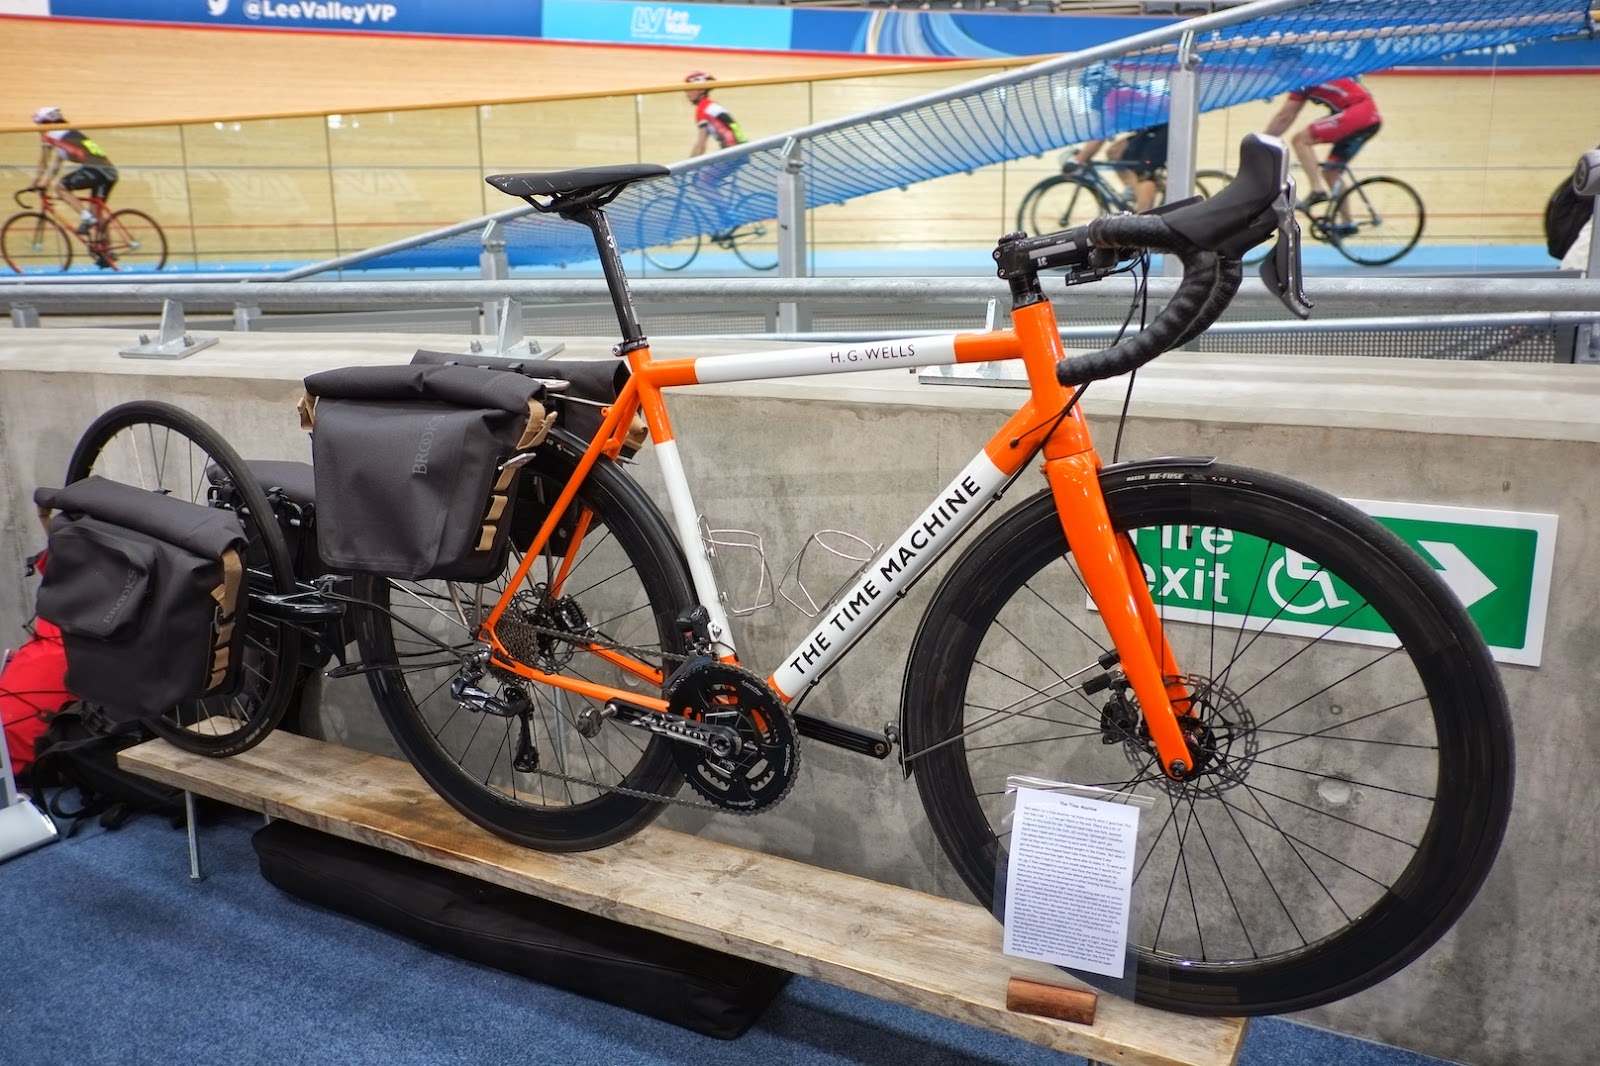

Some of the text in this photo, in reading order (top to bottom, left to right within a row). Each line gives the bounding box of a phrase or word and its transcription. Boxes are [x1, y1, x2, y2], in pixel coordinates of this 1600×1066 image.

[243, 0, 397, 24] @LeeValleyVP
[412, 415, 446, 476] BROOKS
[789, 475, 982, 675] THE TIME MACHINE
[1141, 557, 1232, 605] exit
